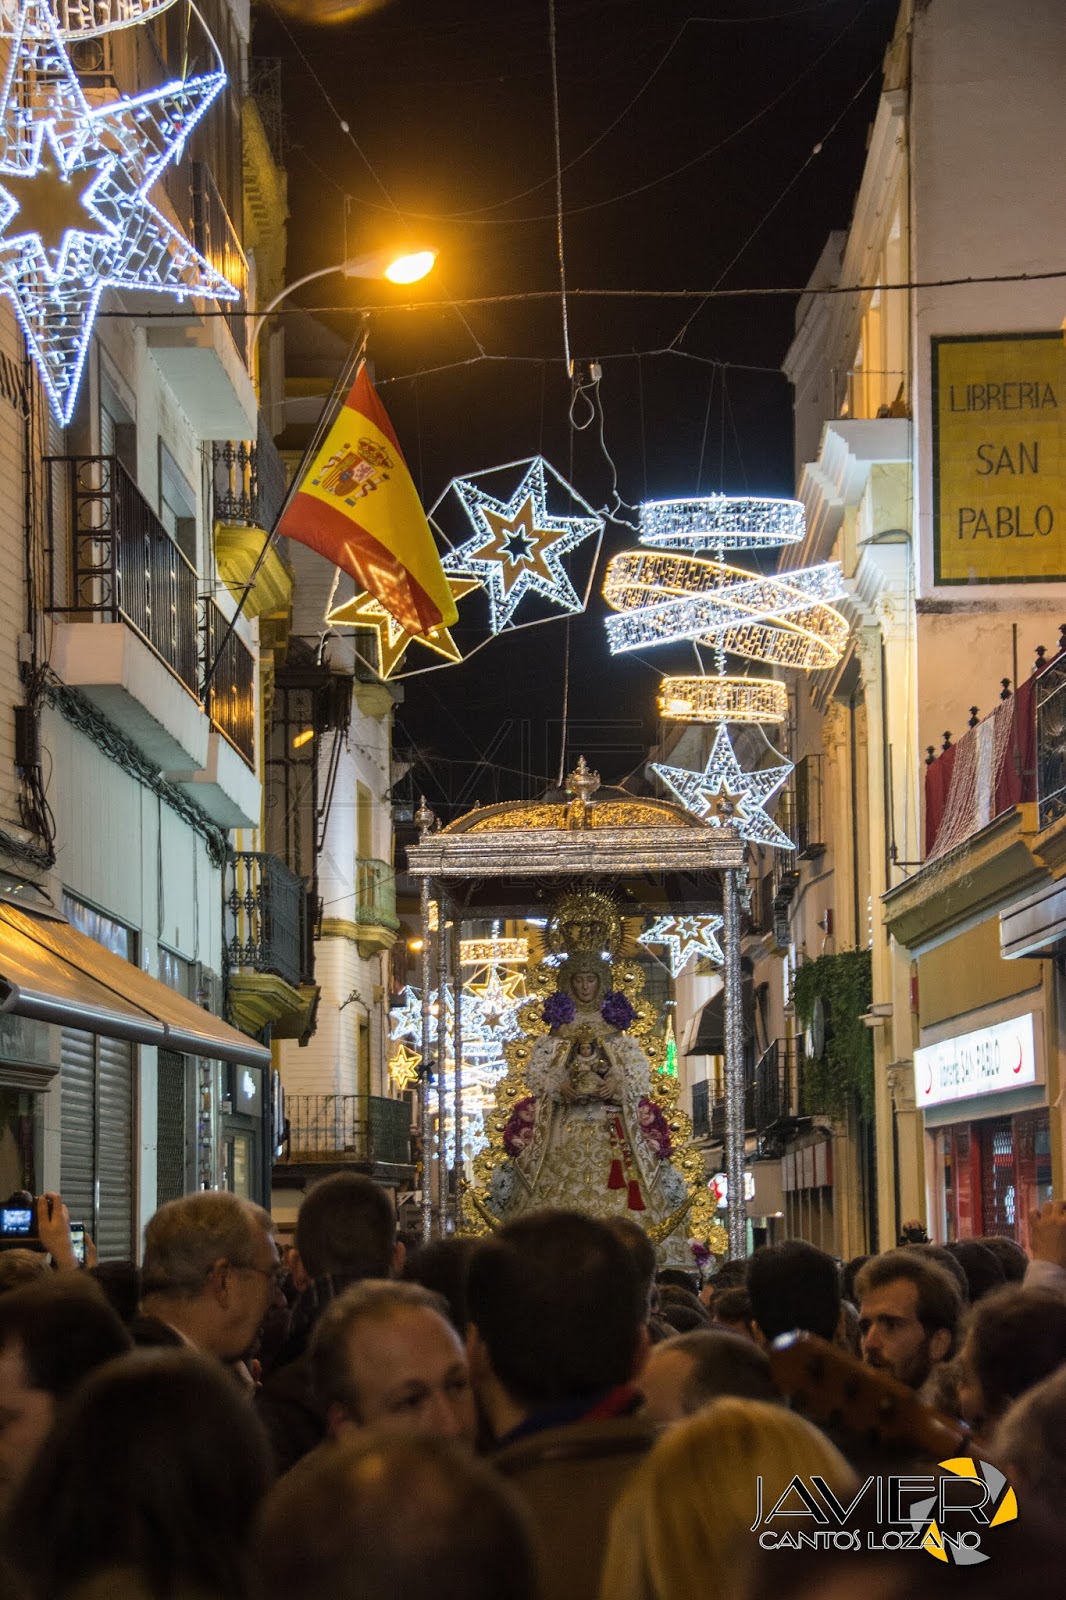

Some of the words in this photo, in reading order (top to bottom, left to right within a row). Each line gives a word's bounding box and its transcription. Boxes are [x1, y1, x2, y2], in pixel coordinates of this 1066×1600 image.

[950, 382, 1058, 412] LIBRERIA
[976, 441, 1039, 476] SAN
[957, 504, 1054, 540] PABLO
